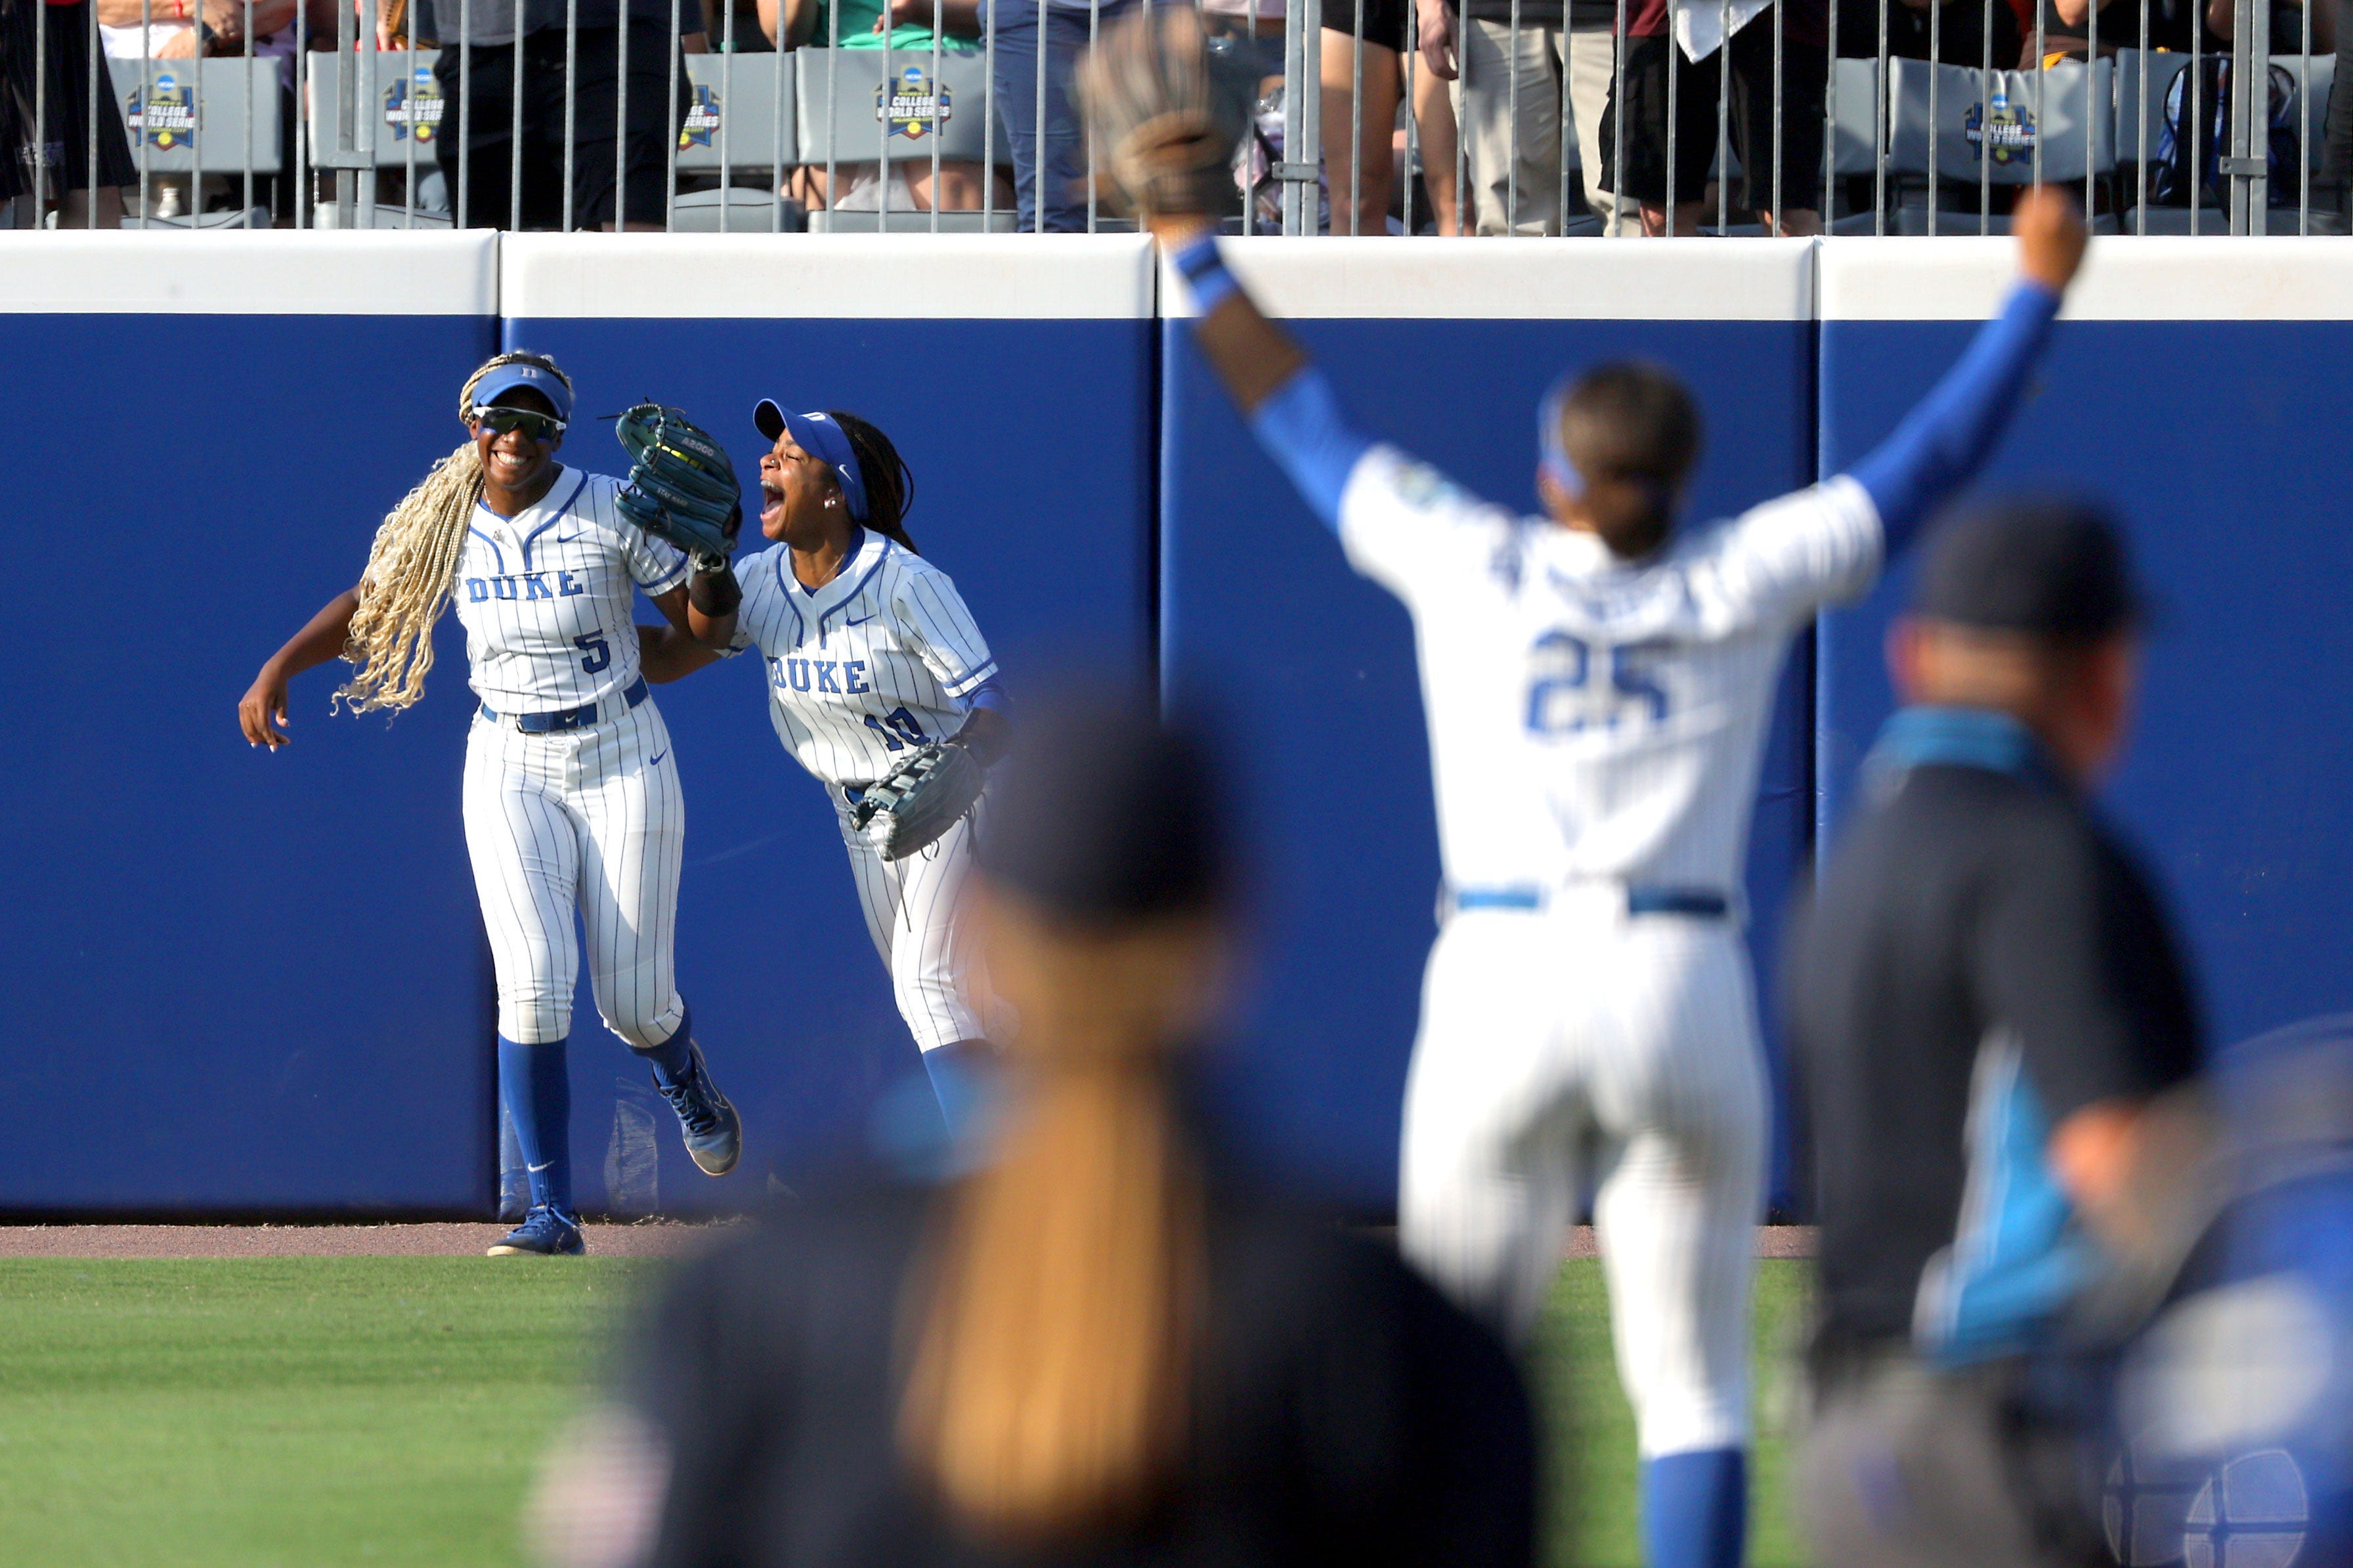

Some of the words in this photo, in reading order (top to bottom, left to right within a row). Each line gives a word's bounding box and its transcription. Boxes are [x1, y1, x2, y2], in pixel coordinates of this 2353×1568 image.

[401, 99, 445, 110] CLLEGE
[892, 96, 936, 107] COLLEGE
[165, 116, 195, 128] SERIE
[681, 437, 714, 456] A2000
[465, 570, 583, 603] DUKE
[573, 629, 611, 674] 5
[1524, 629, 1669, 732] 25
[864, 707, 931, 752] 10
